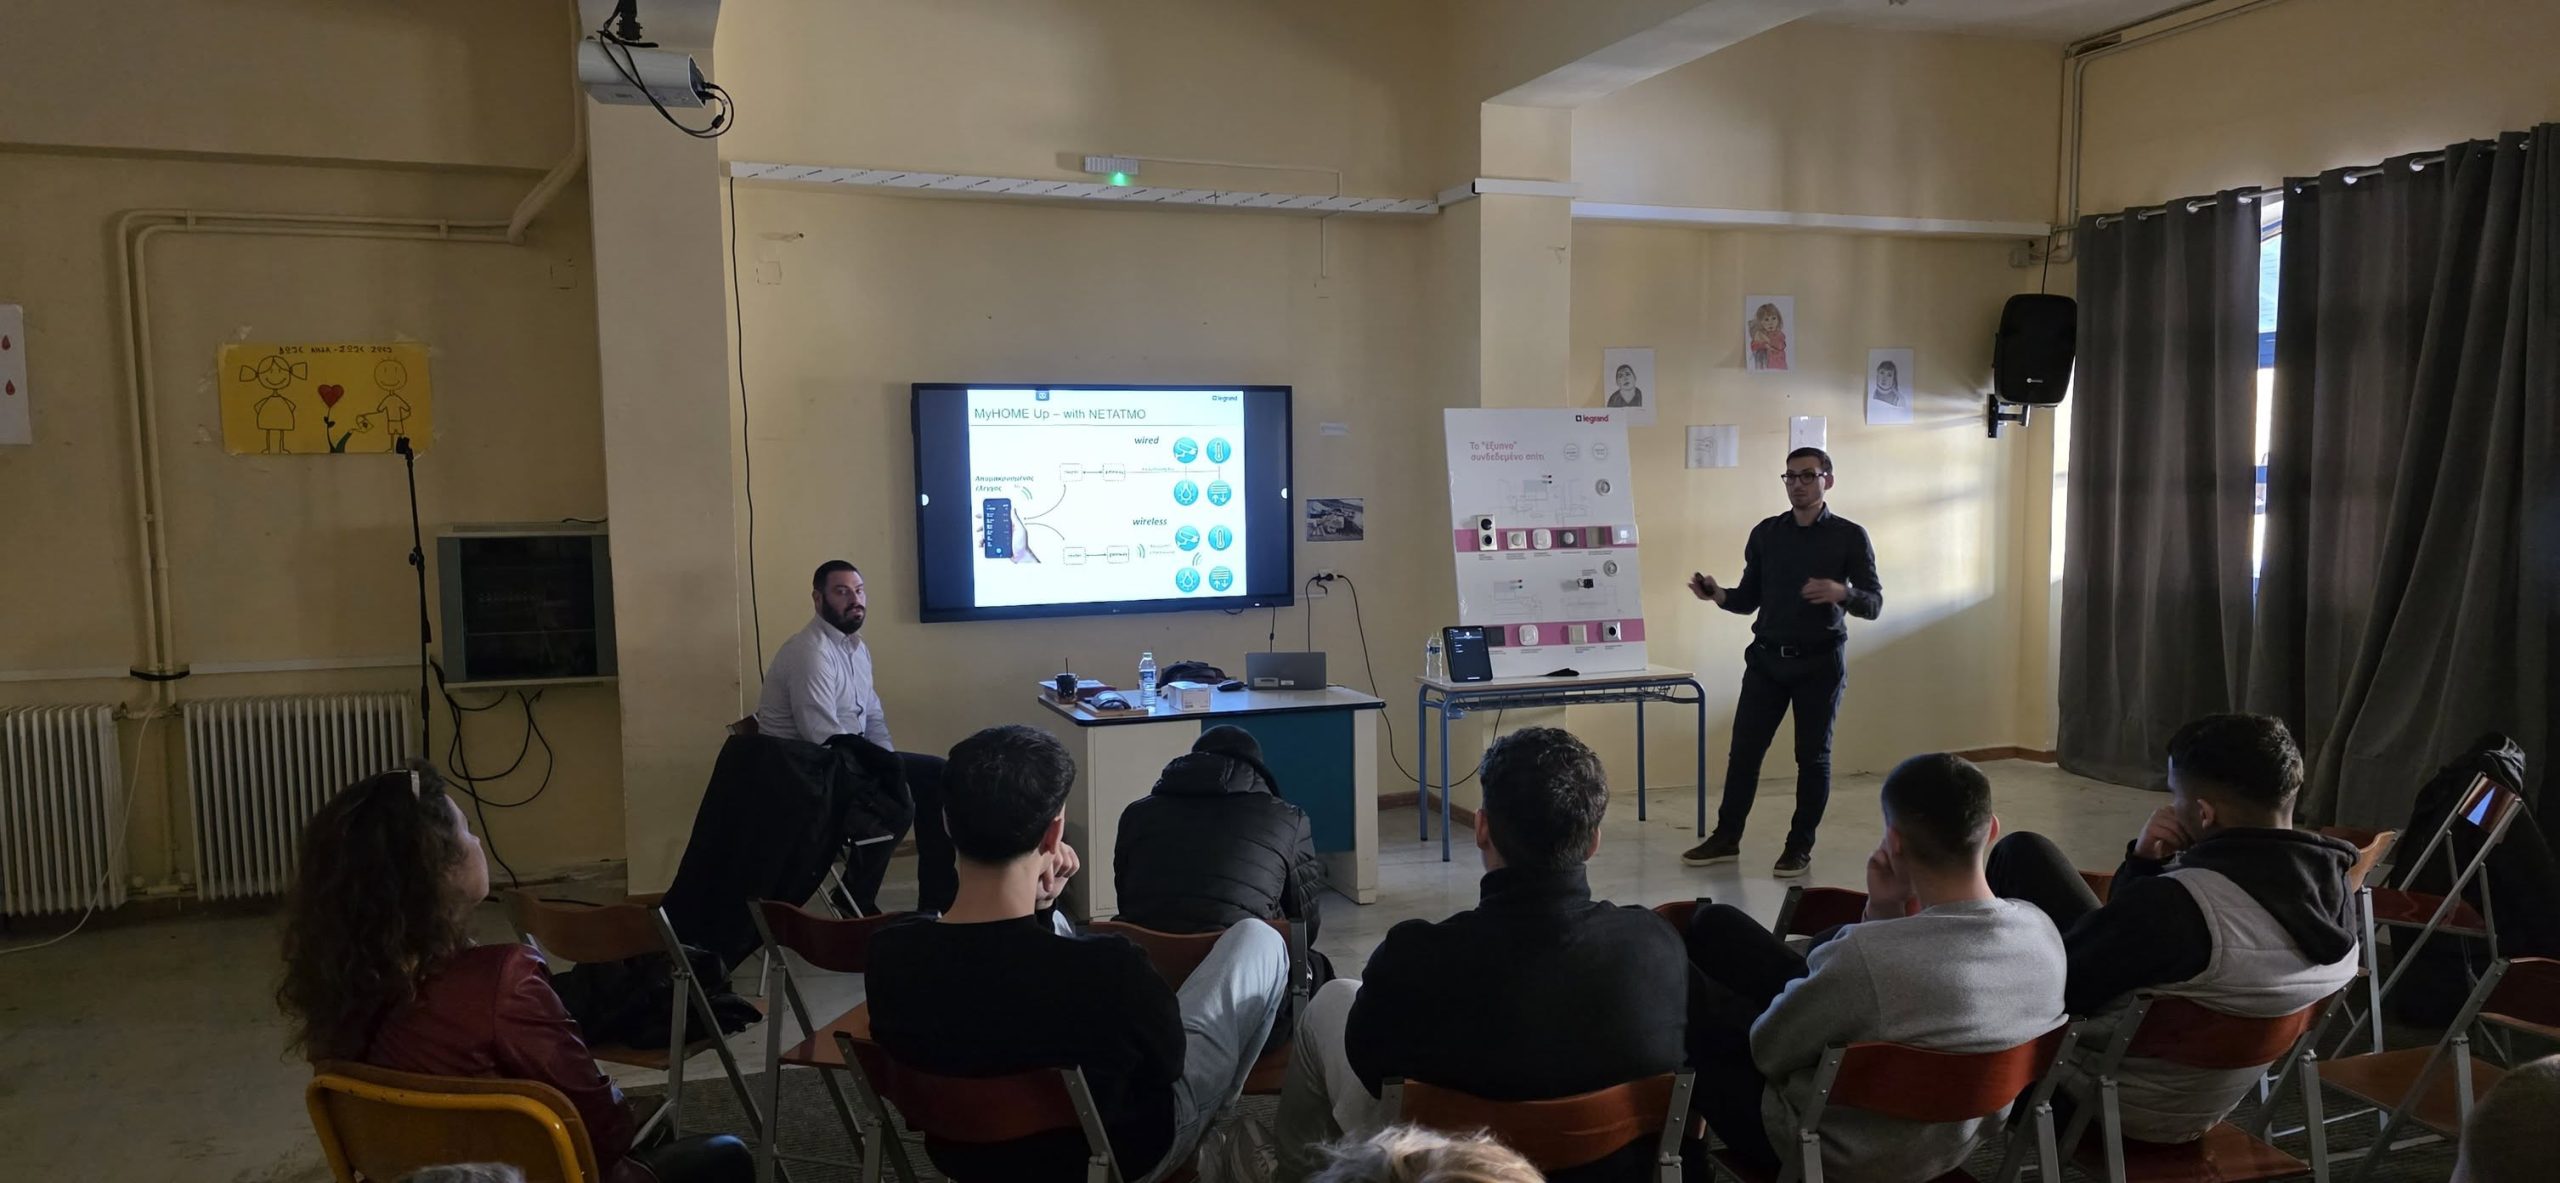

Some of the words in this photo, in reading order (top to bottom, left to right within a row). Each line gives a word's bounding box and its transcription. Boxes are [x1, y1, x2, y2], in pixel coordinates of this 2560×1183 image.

[974, 408, 1029, 421] MyHOME
[1033, 409, 1050, 421] Up
[1063, 409, 1086, 419] with
[1088, 408, 1147, 420] NETATMO
[1583, 414, 1609, 424] legrand
[1134, 436, 1160, 444] wired
[1469, 441, 1480, 450] Το
[1471, 452, 1523, 462] συνδεδεμένο
[1526, 452, 1545, 461] σπίτι
[1132, 517, 1168, 526] wireless
